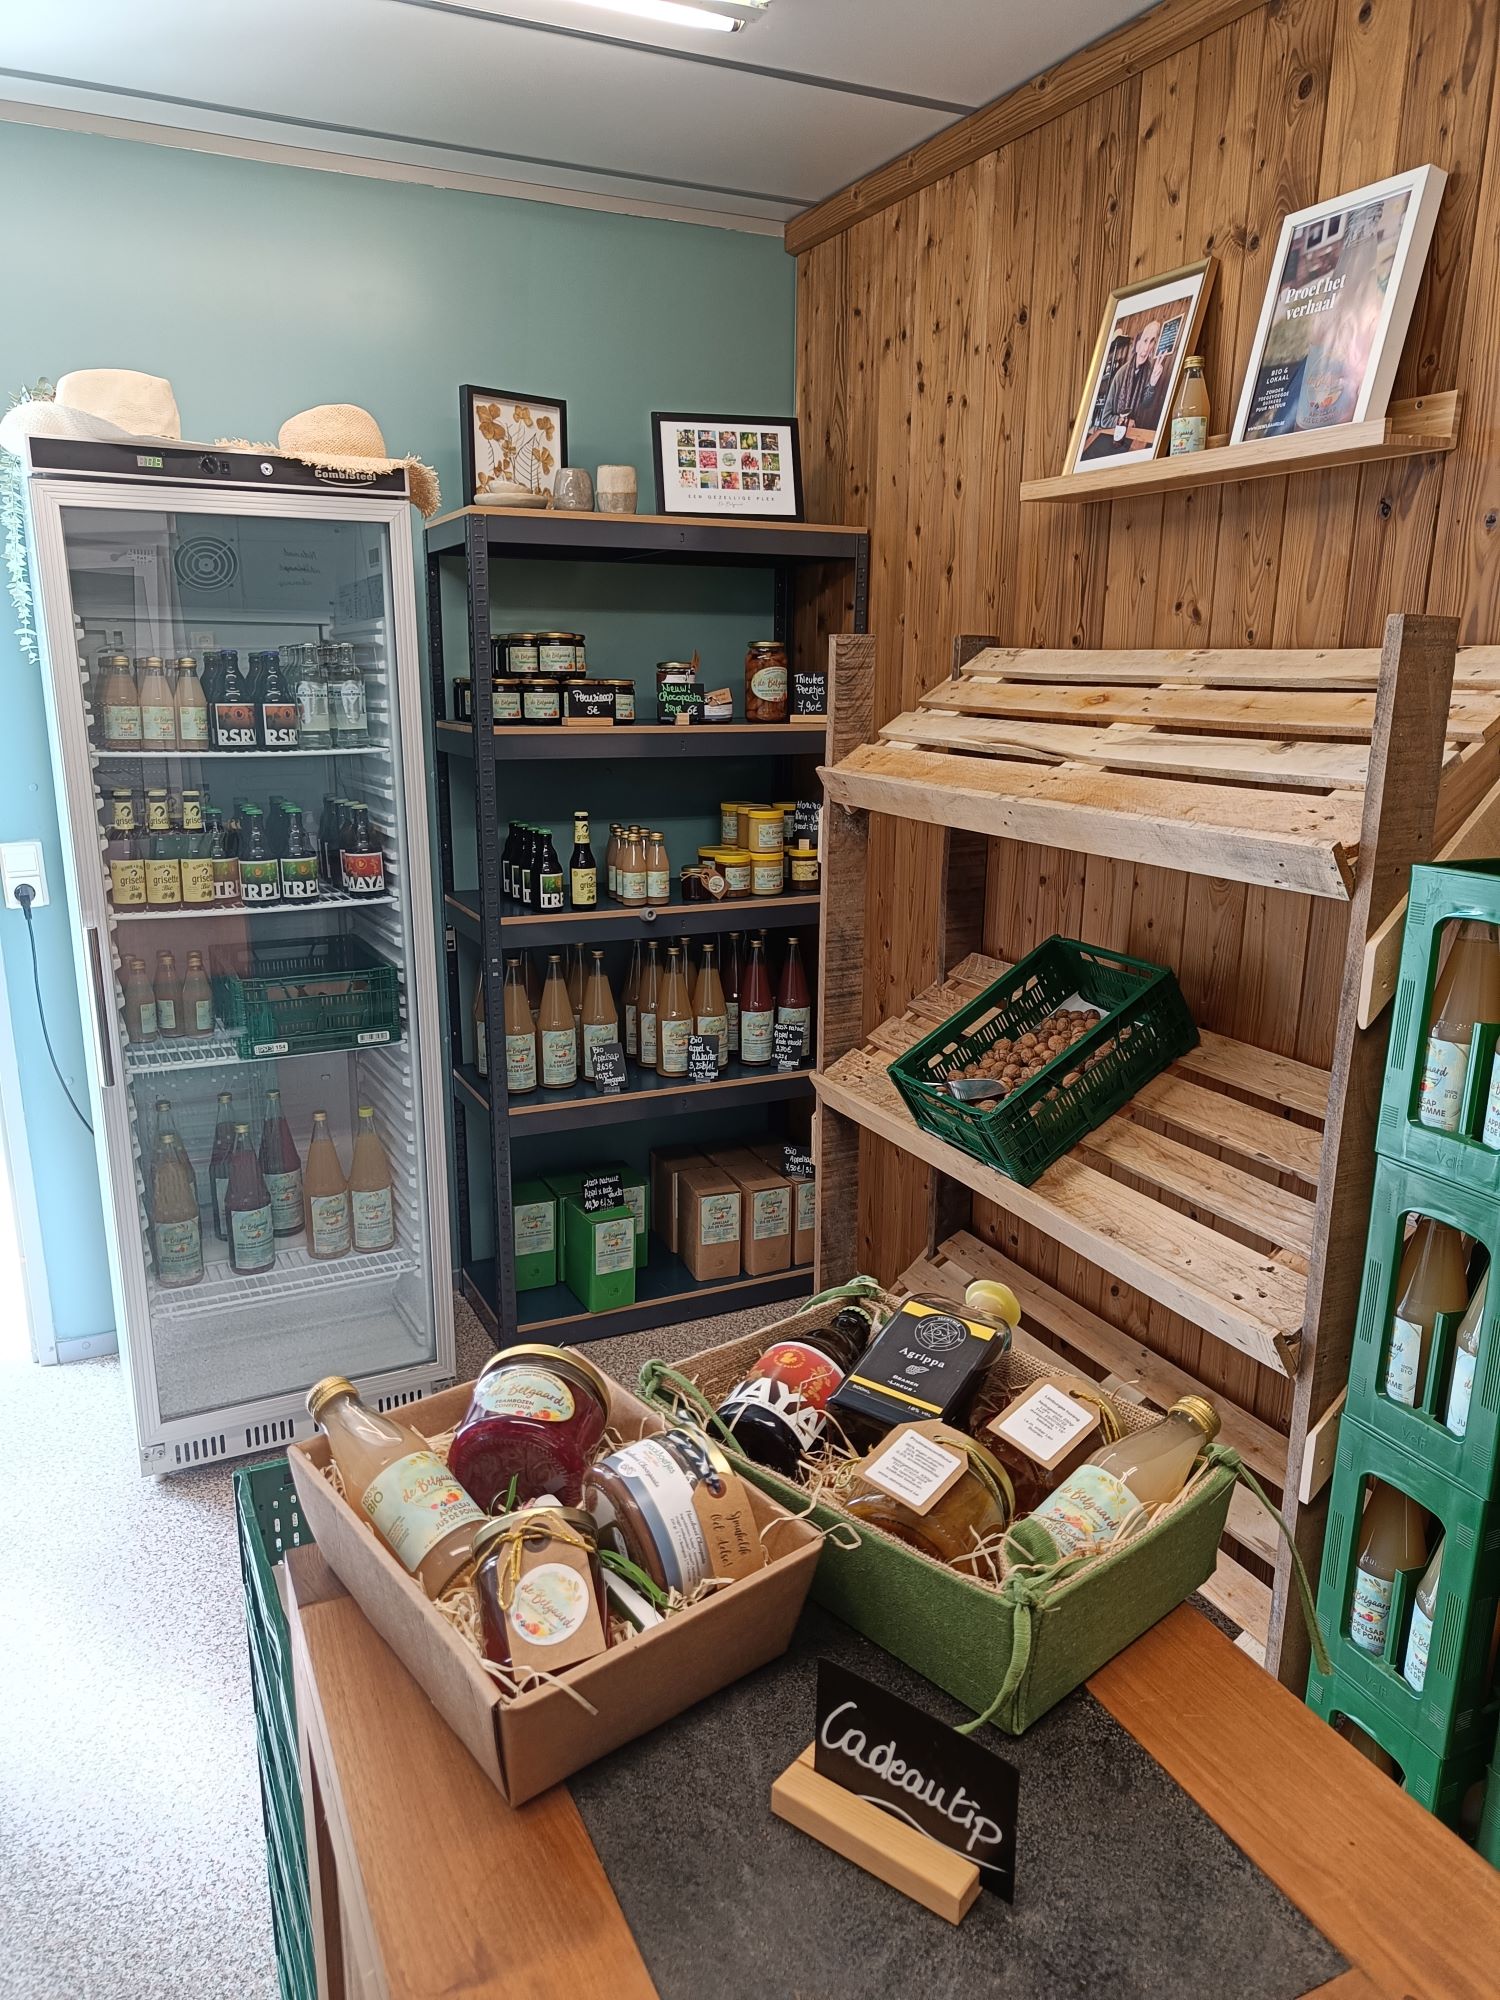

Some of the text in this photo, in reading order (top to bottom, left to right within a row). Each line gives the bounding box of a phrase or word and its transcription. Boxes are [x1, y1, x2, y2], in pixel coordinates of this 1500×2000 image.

[1285, 273, 1347, 305] Proef het
[1285, 293, 1337, 320] verhaal
[1266, 374, 1290, 385] LOKAAL
[1271, 368, 1283, 377] BIO
[1266, 387, 1285, 396] ZONDER
[1268, 402, 1287, 411] NATUUR
[662, 682, 691, 694] Nieuw!
[658, 690, 704, 705] Chocopasta
[586, 705, 601, 715] 5€
[687, 704, 699, 716] 6€
[797, 700, 823, 715] 7,90€
[688, 1035, 703, 1044] Bio
[592, 1046, 604, 1054] Bio
[783, 1146, 797, 1156] Bio
[898, 1346, 946, 1369] Agrippa
[891, 1374, 920, 1388] BRAMEN
[495, 1398, 535, 1406] FRAMBOZEN
[506, 1383, 565, 1408] Belgaard
[1457, 1417, 1466, 1428] JU
[362, 1485, 378, 1506] 100%
[366, 1490, 384, 1515] BIO
[402, 1488, 418, 1504] de
[1060, 1484, 1121, 1532] de Belgaard
[435, 1518, 449, 1531] JUS
[449, 1511, 460, 1522] DE
[520, 1582, 574, 1629] de Belgaard
[821, 1700, 1004, 1853] Cadeautip
